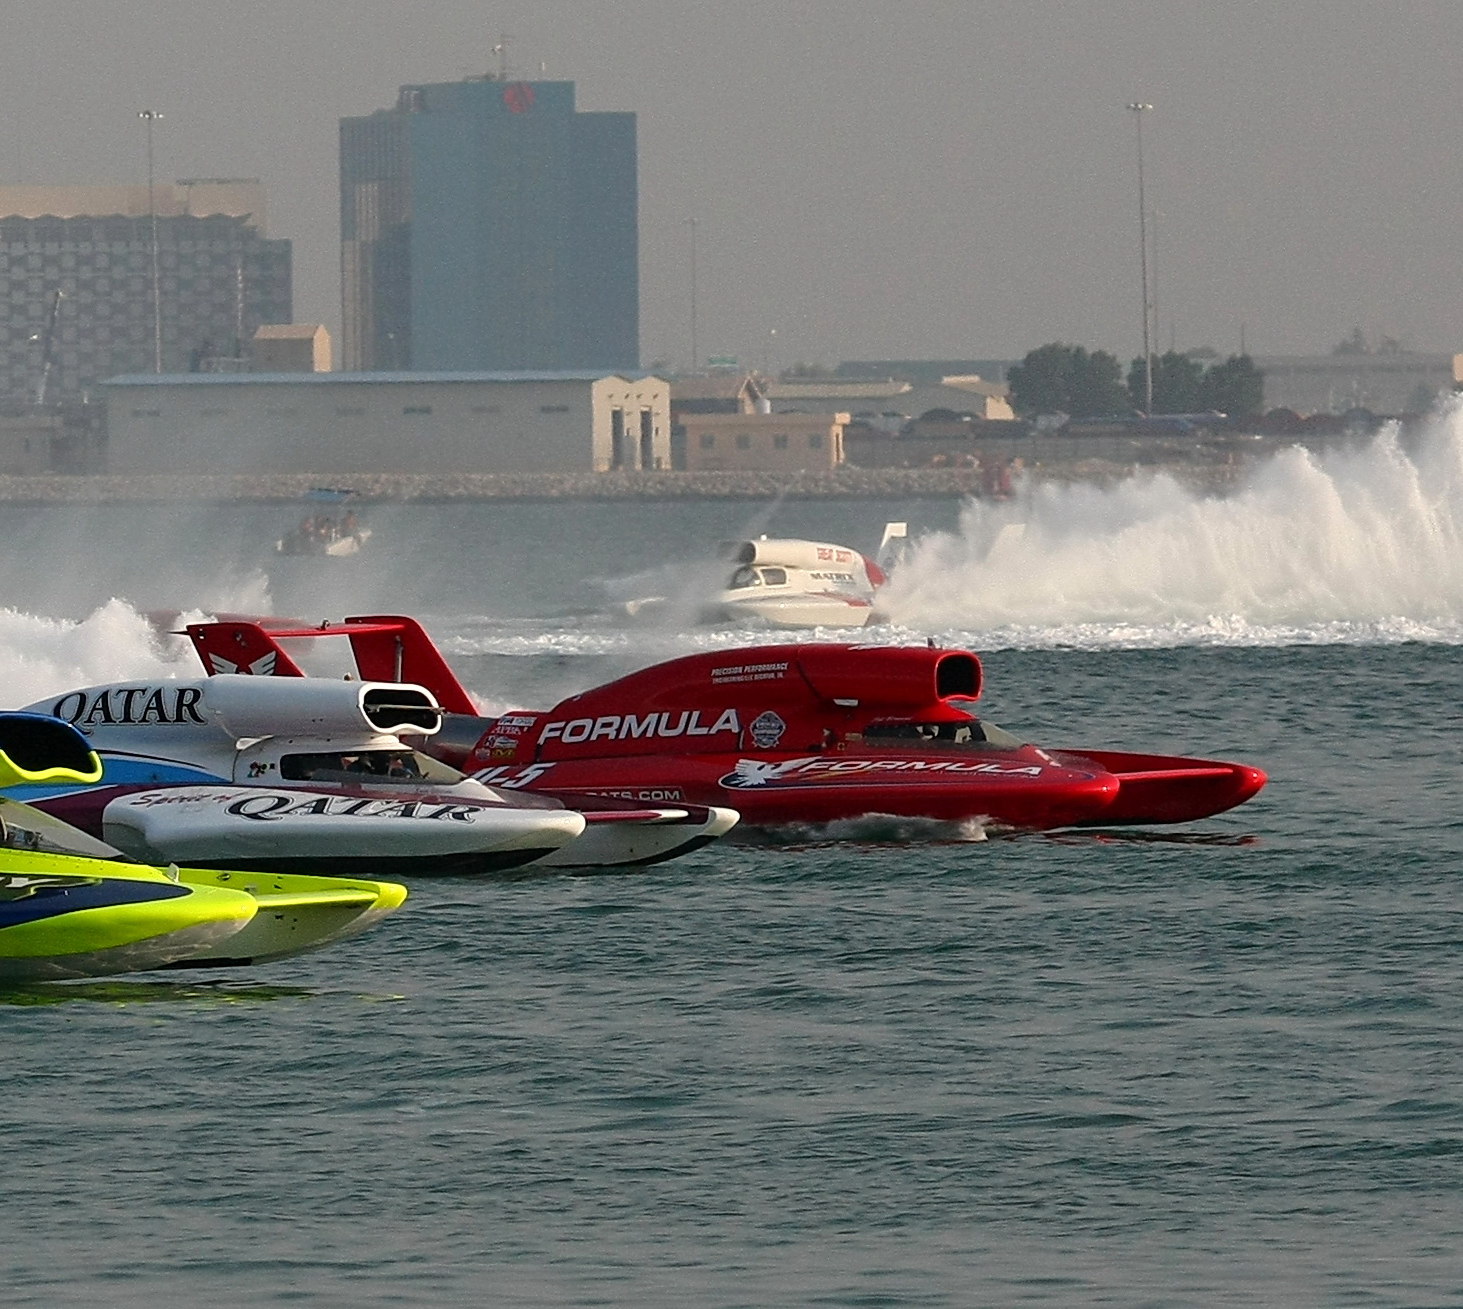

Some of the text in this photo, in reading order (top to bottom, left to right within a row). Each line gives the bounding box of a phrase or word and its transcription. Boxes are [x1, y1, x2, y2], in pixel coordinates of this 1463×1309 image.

[52, 686, 207, 736] QATAR
[538, 708, 740, 745] FORMULA
[799, 760, 1043, 776] FORMULA
[224, 794, 485, 824] QATAR
